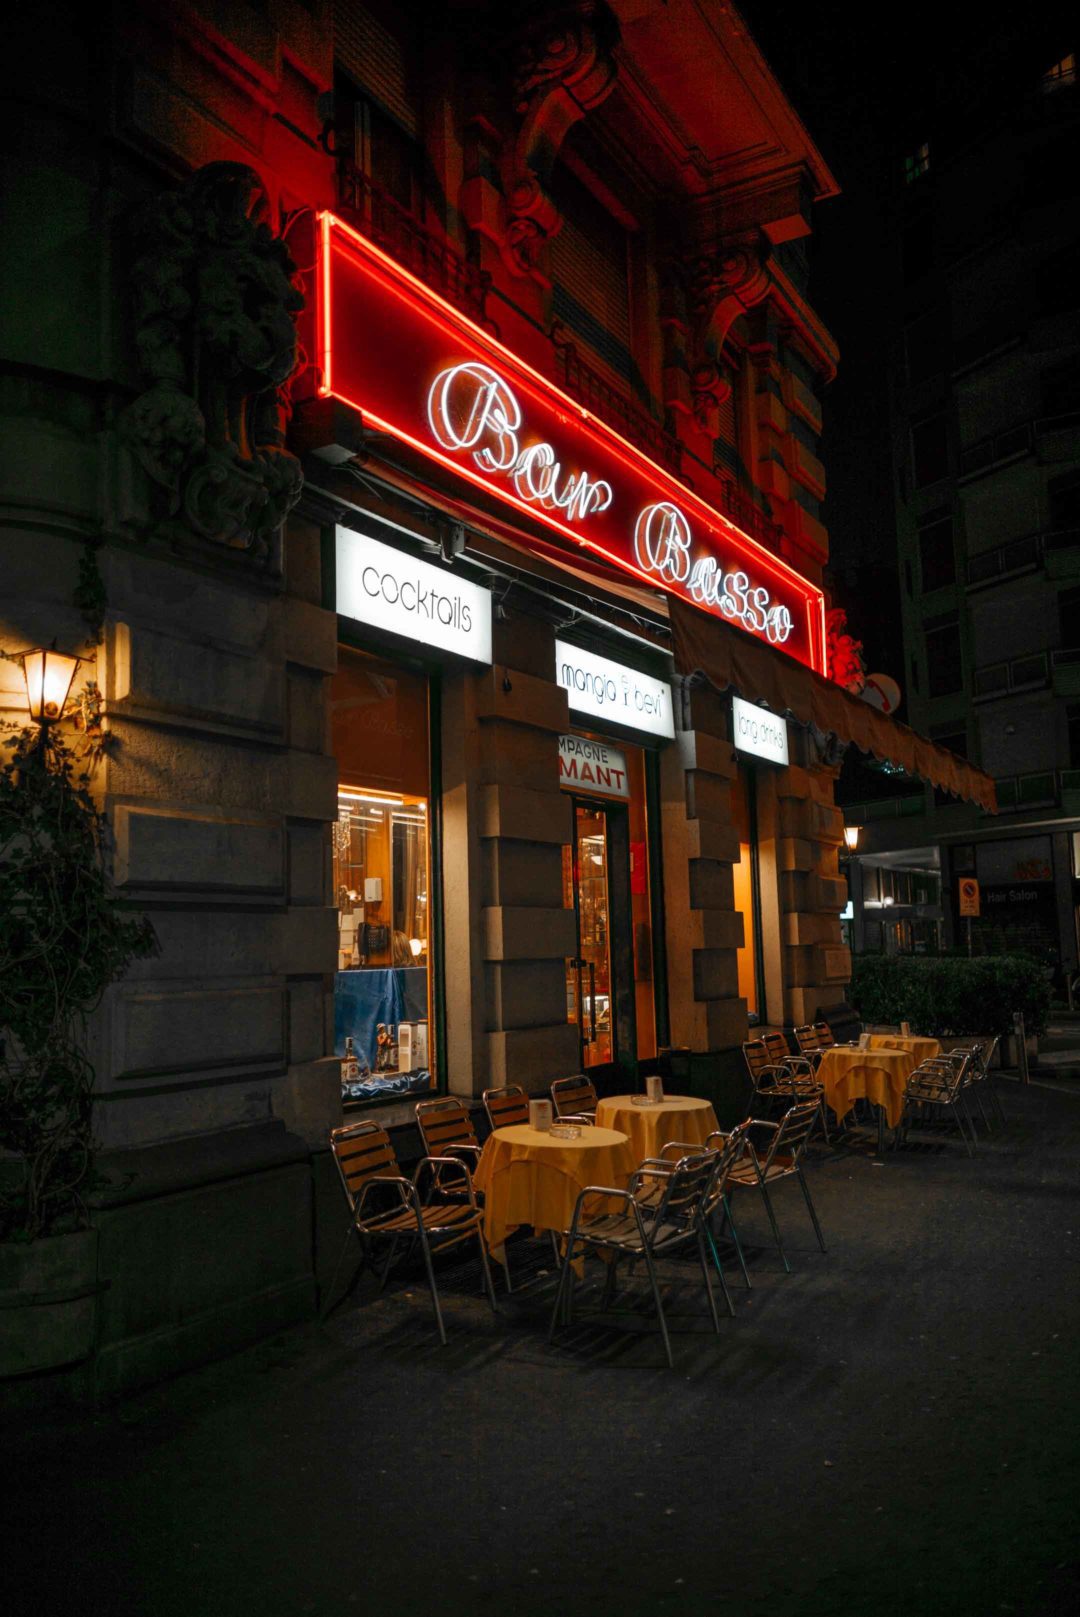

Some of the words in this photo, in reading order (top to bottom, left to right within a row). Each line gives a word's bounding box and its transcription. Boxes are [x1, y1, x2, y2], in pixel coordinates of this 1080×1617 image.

[361, 566, 473, 633] cocktails
[635, 501, 794, 643] Basso
[1008, 889, 1039, 903] Salon
